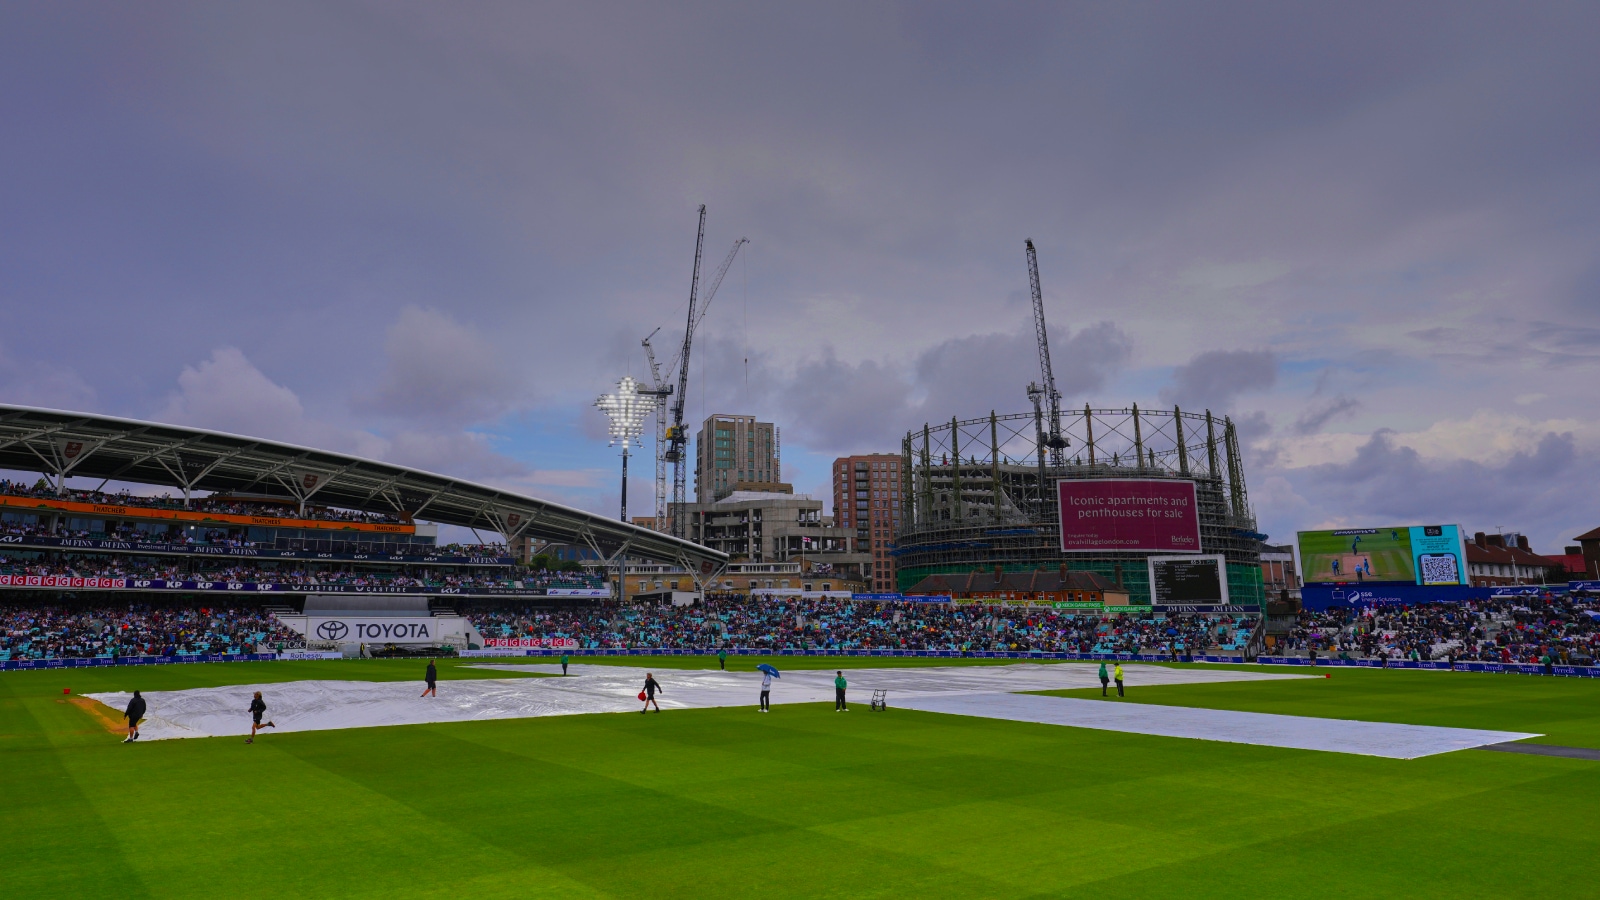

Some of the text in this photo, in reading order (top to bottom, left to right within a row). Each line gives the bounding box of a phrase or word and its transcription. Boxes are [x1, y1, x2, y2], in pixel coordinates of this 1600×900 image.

[1070, 495, 1188, 507] Iconic apartments and
[93, 505, 126, 514] THATCHERS
[1078, 508, 1183, 519] penthouses for sale
[252, 518, 281, 526] THATCHERS
[1171, 535, 1194, 546] Berkeley
[13, 576, 24, 585] IG
[28, 577, 39, 585] IG
[43, 577, 54, 586] IG
[58, 577, 68, 586] IG
[72, 578, 82, 586] IG
[86, 578, 96, 587] IG
[100, 578, 110, 587] IG
[114, 579, 124, 587] IG
[134, 580, 151, 588] KP
[197, 581, 213, 589] KP
[227, 582, 243, 590] KP
[257, 583, 273, 591] KP
[356, 623, 429, 638] TOYOTA
[290, 652, 322, 660] Rothesay
